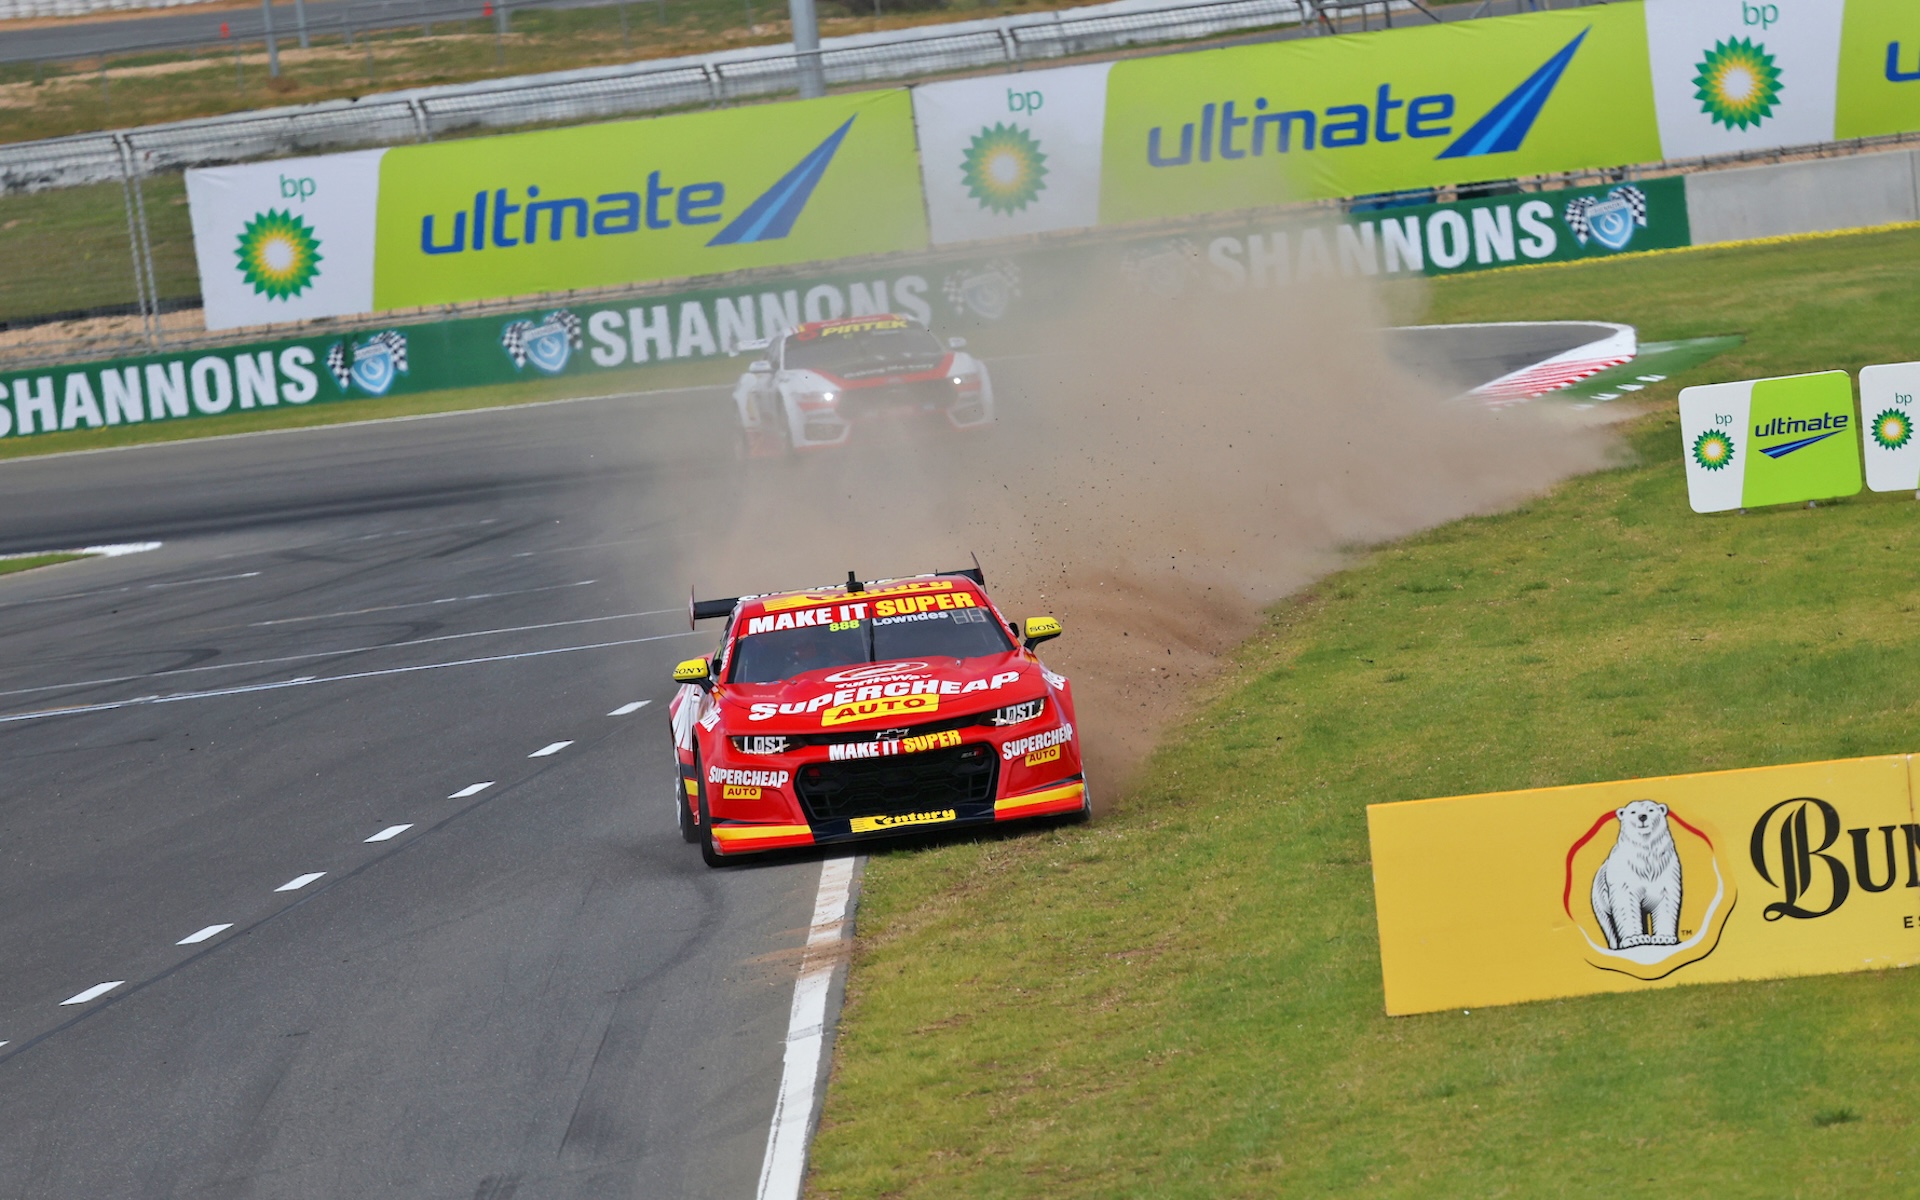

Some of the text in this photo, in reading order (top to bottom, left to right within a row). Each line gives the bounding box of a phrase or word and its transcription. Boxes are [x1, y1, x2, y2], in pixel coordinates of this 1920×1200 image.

[1741, 1, 1780, 31] bp
[1007, 88, 1044, 116] bp
[1147, 82, 1456, 168] ultimate
[279, 174, 317, 200] bp
[420, 169, 726, 255] ultimate
[1208, 199, 1558, 290] SHANNONS
[588, 275, 931, 368] SHANNONS
[821, 319, 909, 338] PIRTEK
[1893, 392, 1913, 407] bp
[1715, 413, 1733, 427] bp
[1754, 411, 1849, 438] ultimate
[748, 591, 976, 635] MAKE IT SUPER
[829, 619, 860, 632] 888
[872, 610, 949, 627] Lowndes
[748, 670, 1020, 722] SUPERCHEAP
[834, 698, 927, 721] AUTO
[829, 729, 962, 761] MAKE IT SUPER
[1001, 722, 1074, 761] SUPERCHEAP
[1029, 748, 1056, 763] AUTO
[708, 765, 790, 789] SUPERCHEAP
[727, 786, 758, 797] AUTO
[1681, 929, 1693, 937] TM
